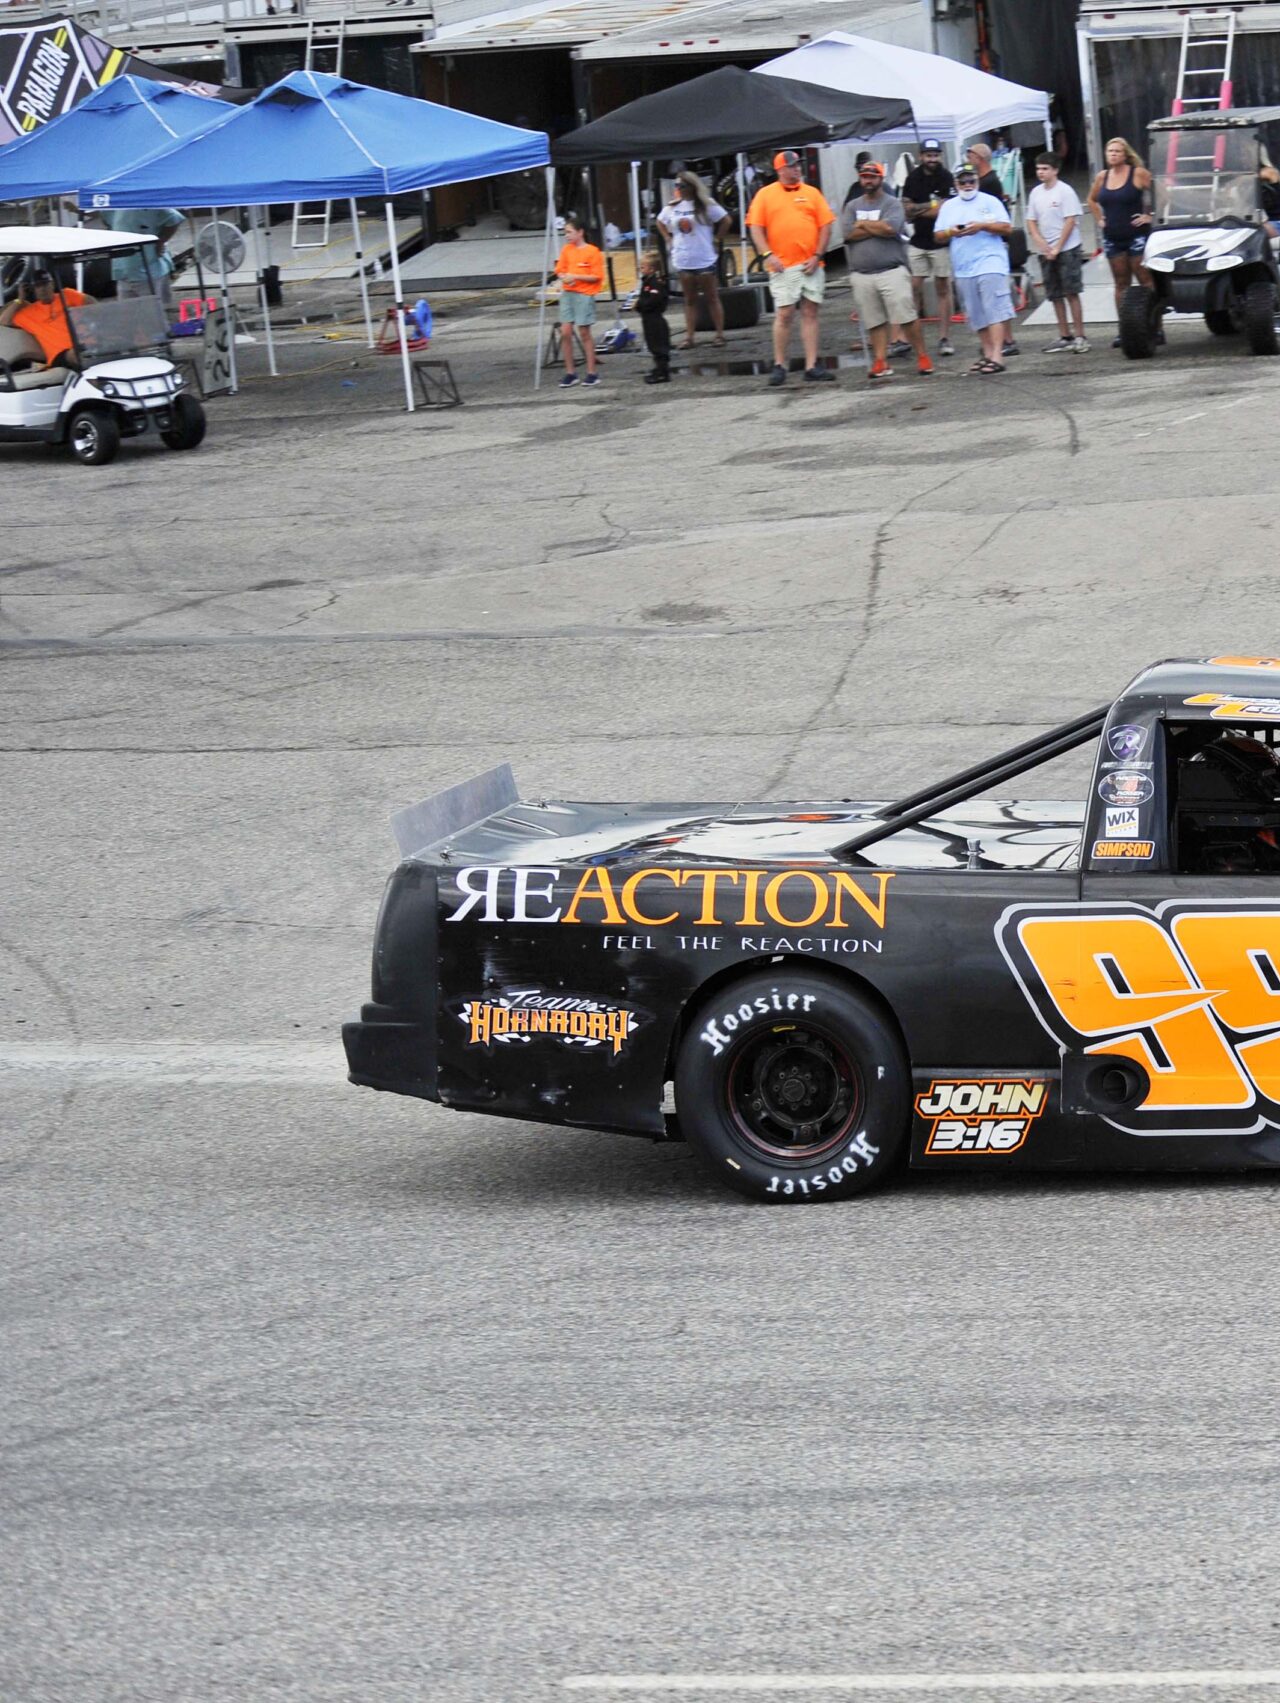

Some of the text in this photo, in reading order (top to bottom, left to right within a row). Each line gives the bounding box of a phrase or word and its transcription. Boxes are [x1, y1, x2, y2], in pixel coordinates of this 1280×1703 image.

[17, 37, 71, 124] PARAGON
[1107, 810, 1137, 827] WIX
[1096, 843, 1151, 857] SIMPSON
[603, 935, 883, 953] FEEL THE REACTION
[469, 1001, 628, 1056] HORNADAY
[700, 988, 817, 1056] Hoosier
[920, 1084, 1045, 1114] JOHN
[931, 1121, 1026, 1149] 3:16
[766, 1130, 880, 1197] Hoosier
